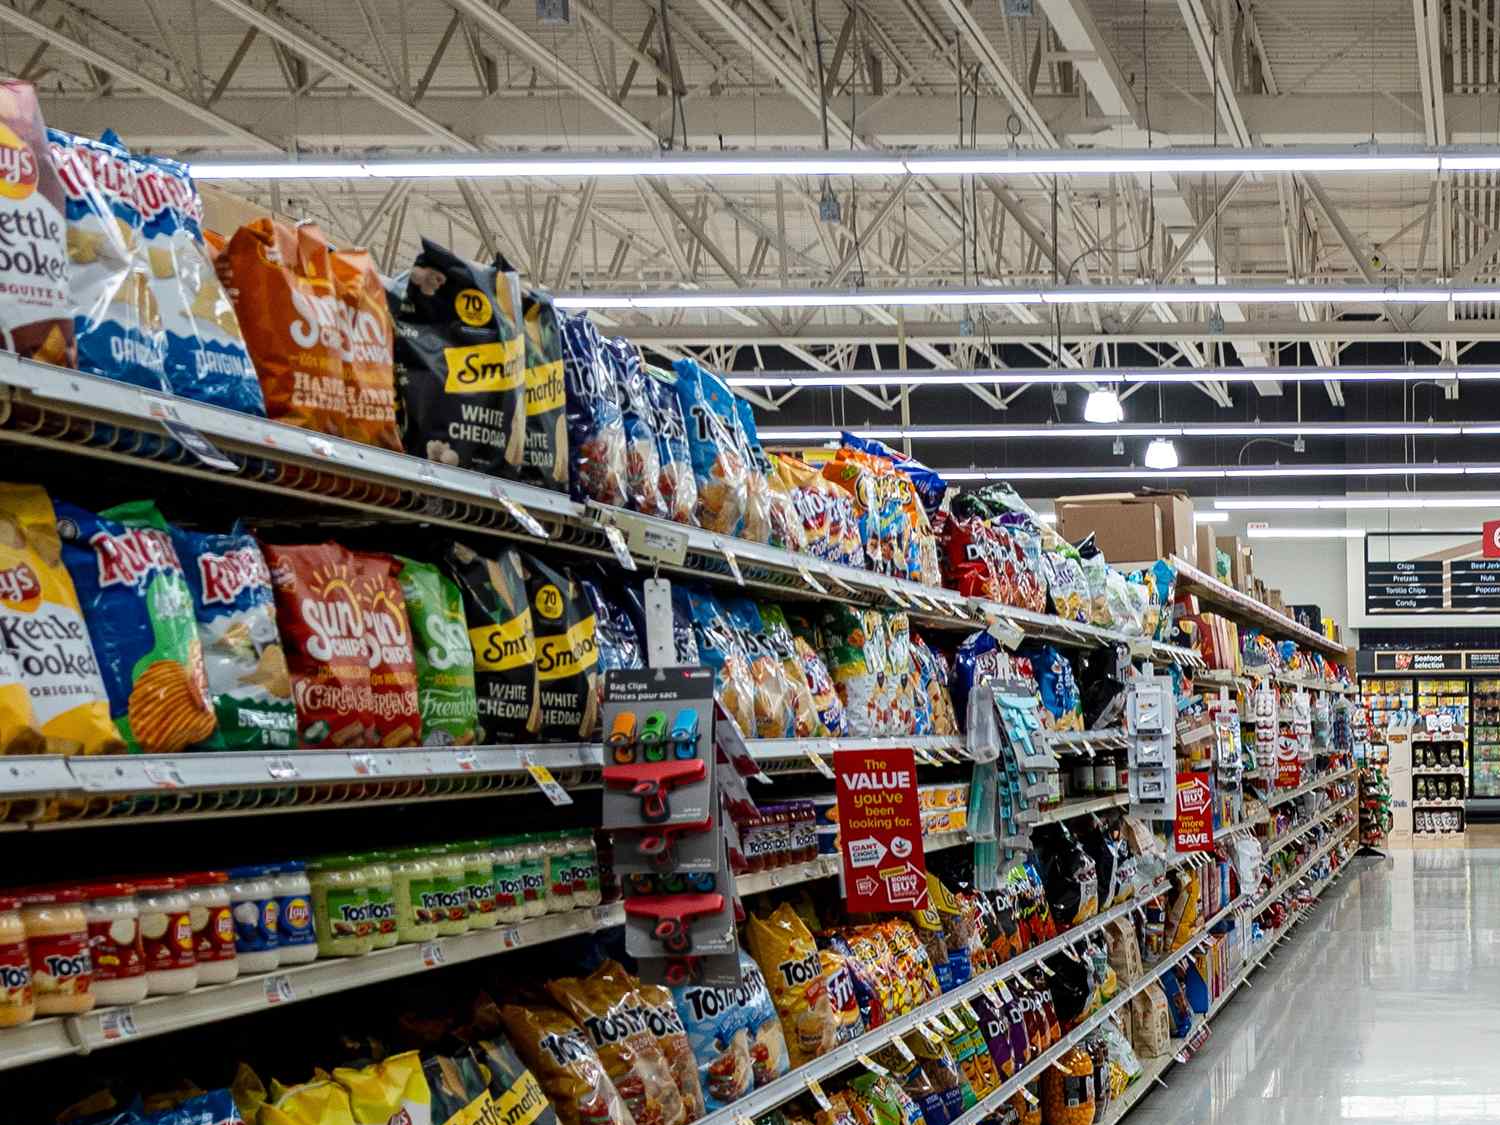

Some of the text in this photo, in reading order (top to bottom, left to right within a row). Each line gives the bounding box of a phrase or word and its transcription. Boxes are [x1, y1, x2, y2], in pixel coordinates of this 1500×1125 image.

[0, 207, 60, 243] ettle
[463, 294, 483, 310] 70
[461, 404, 505, 428] WHITE
[449, 421, 506, 450] CHEDDAR
[524, 430, 549, 449] HITE
[1397, 563, 1415, 572] Chips
[1471, 562, 1486, 570] Beef
[1480, 574, 1496, 582] Nuts
[1408, 586, 1427, 595] Chips
[2, 616, 84, 652] Kettle
[1414, 655, 1443, 663] Seafood
[489, 682, 527, 701] WHITE
[610, 681, 648, 692] Bag Clips
[540, 692, 578, 709] WHITE
[610, 691, 678, 702] Pinces pour sacs
[540, 708, 582, 725] HEDDAR
[864, 759, 887, 770] The
[843, 771, 911, 791] VALUE
[854, 791, 903, 808] you've
[865, 806, 894, 816] been
[849, 816, 892, 830] looking
[1181, 820, 1205, 828] more
[891, 880, 918, 892] BUY
